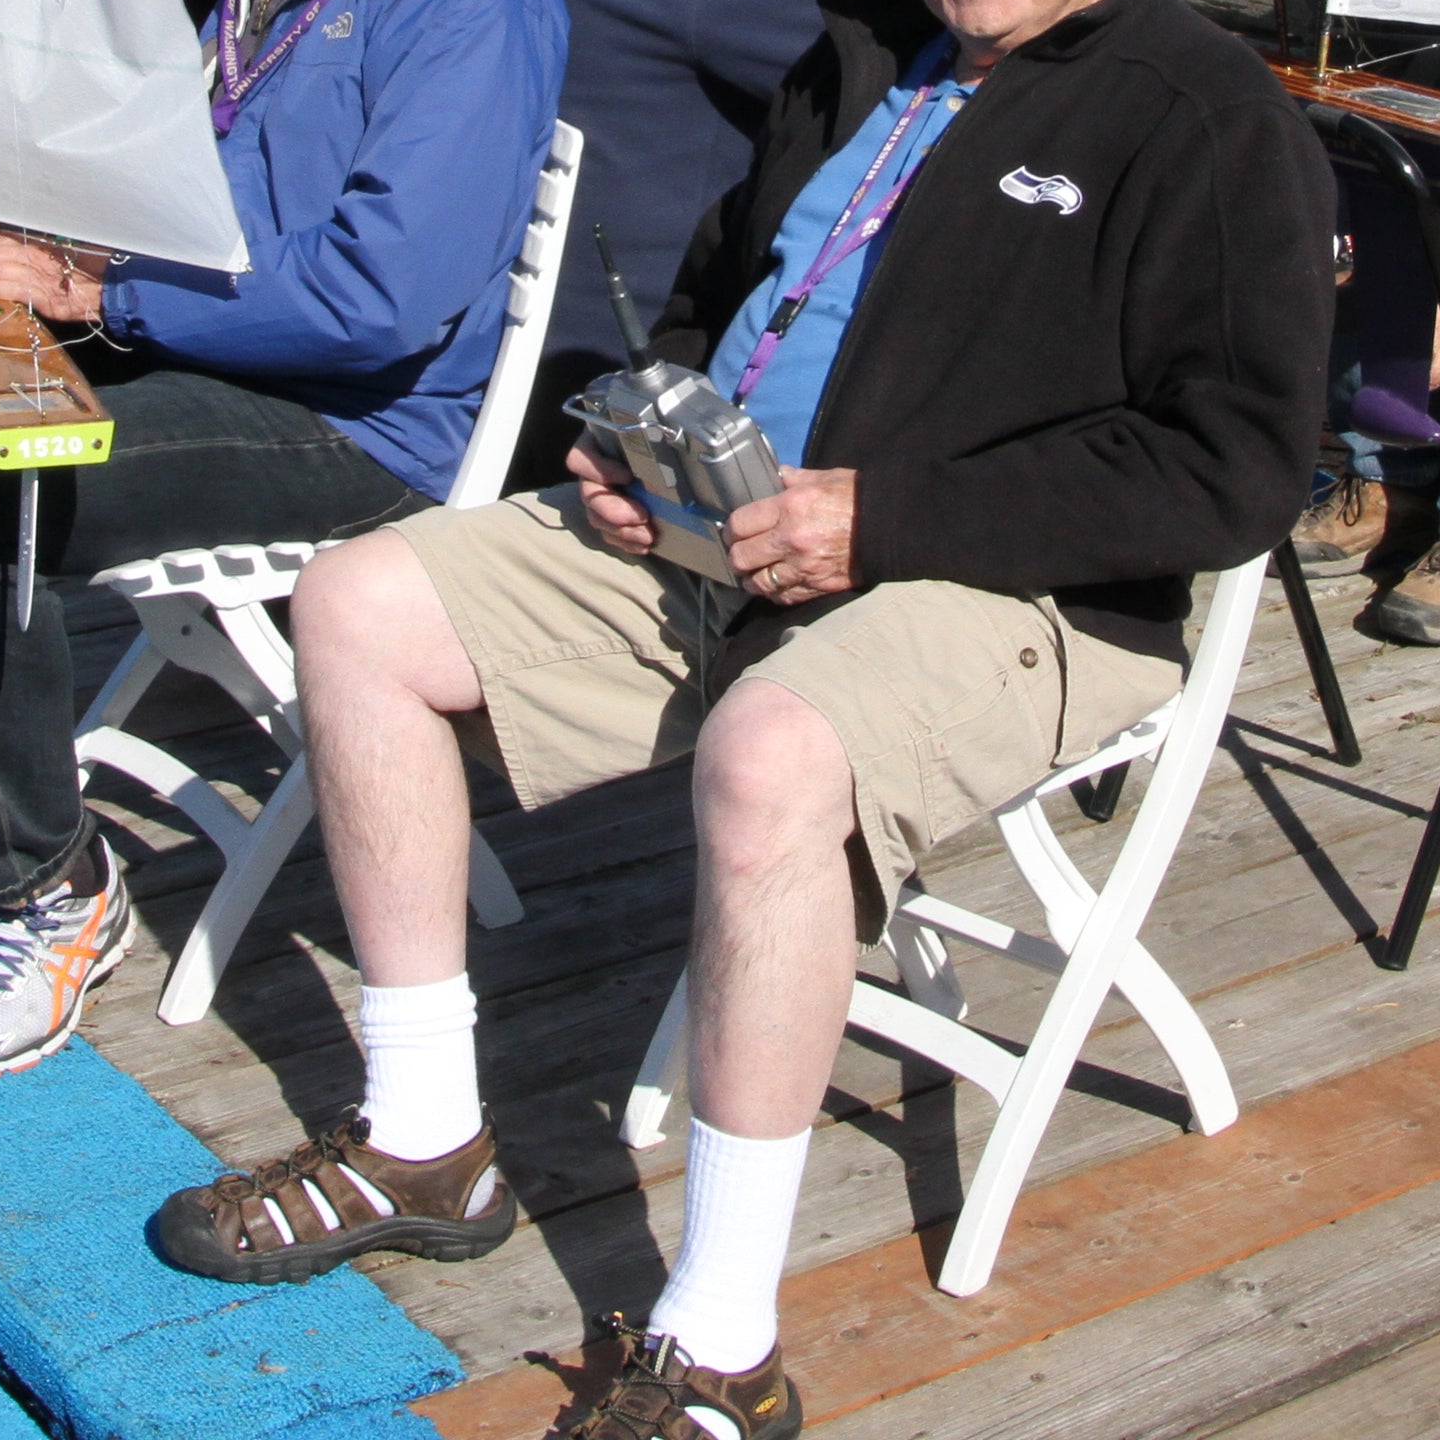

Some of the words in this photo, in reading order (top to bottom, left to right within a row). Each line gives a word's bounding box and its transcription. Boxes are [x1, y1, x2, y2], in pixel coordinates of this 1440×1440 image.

[230, 25, 303, 101] UNIVERSITY
[305, 2, 321, 22] OF
[831, 209, 852, 237] UW
[865, 115, 912, 181] HUSKIES
[18, 436, 83, 458] 1520
